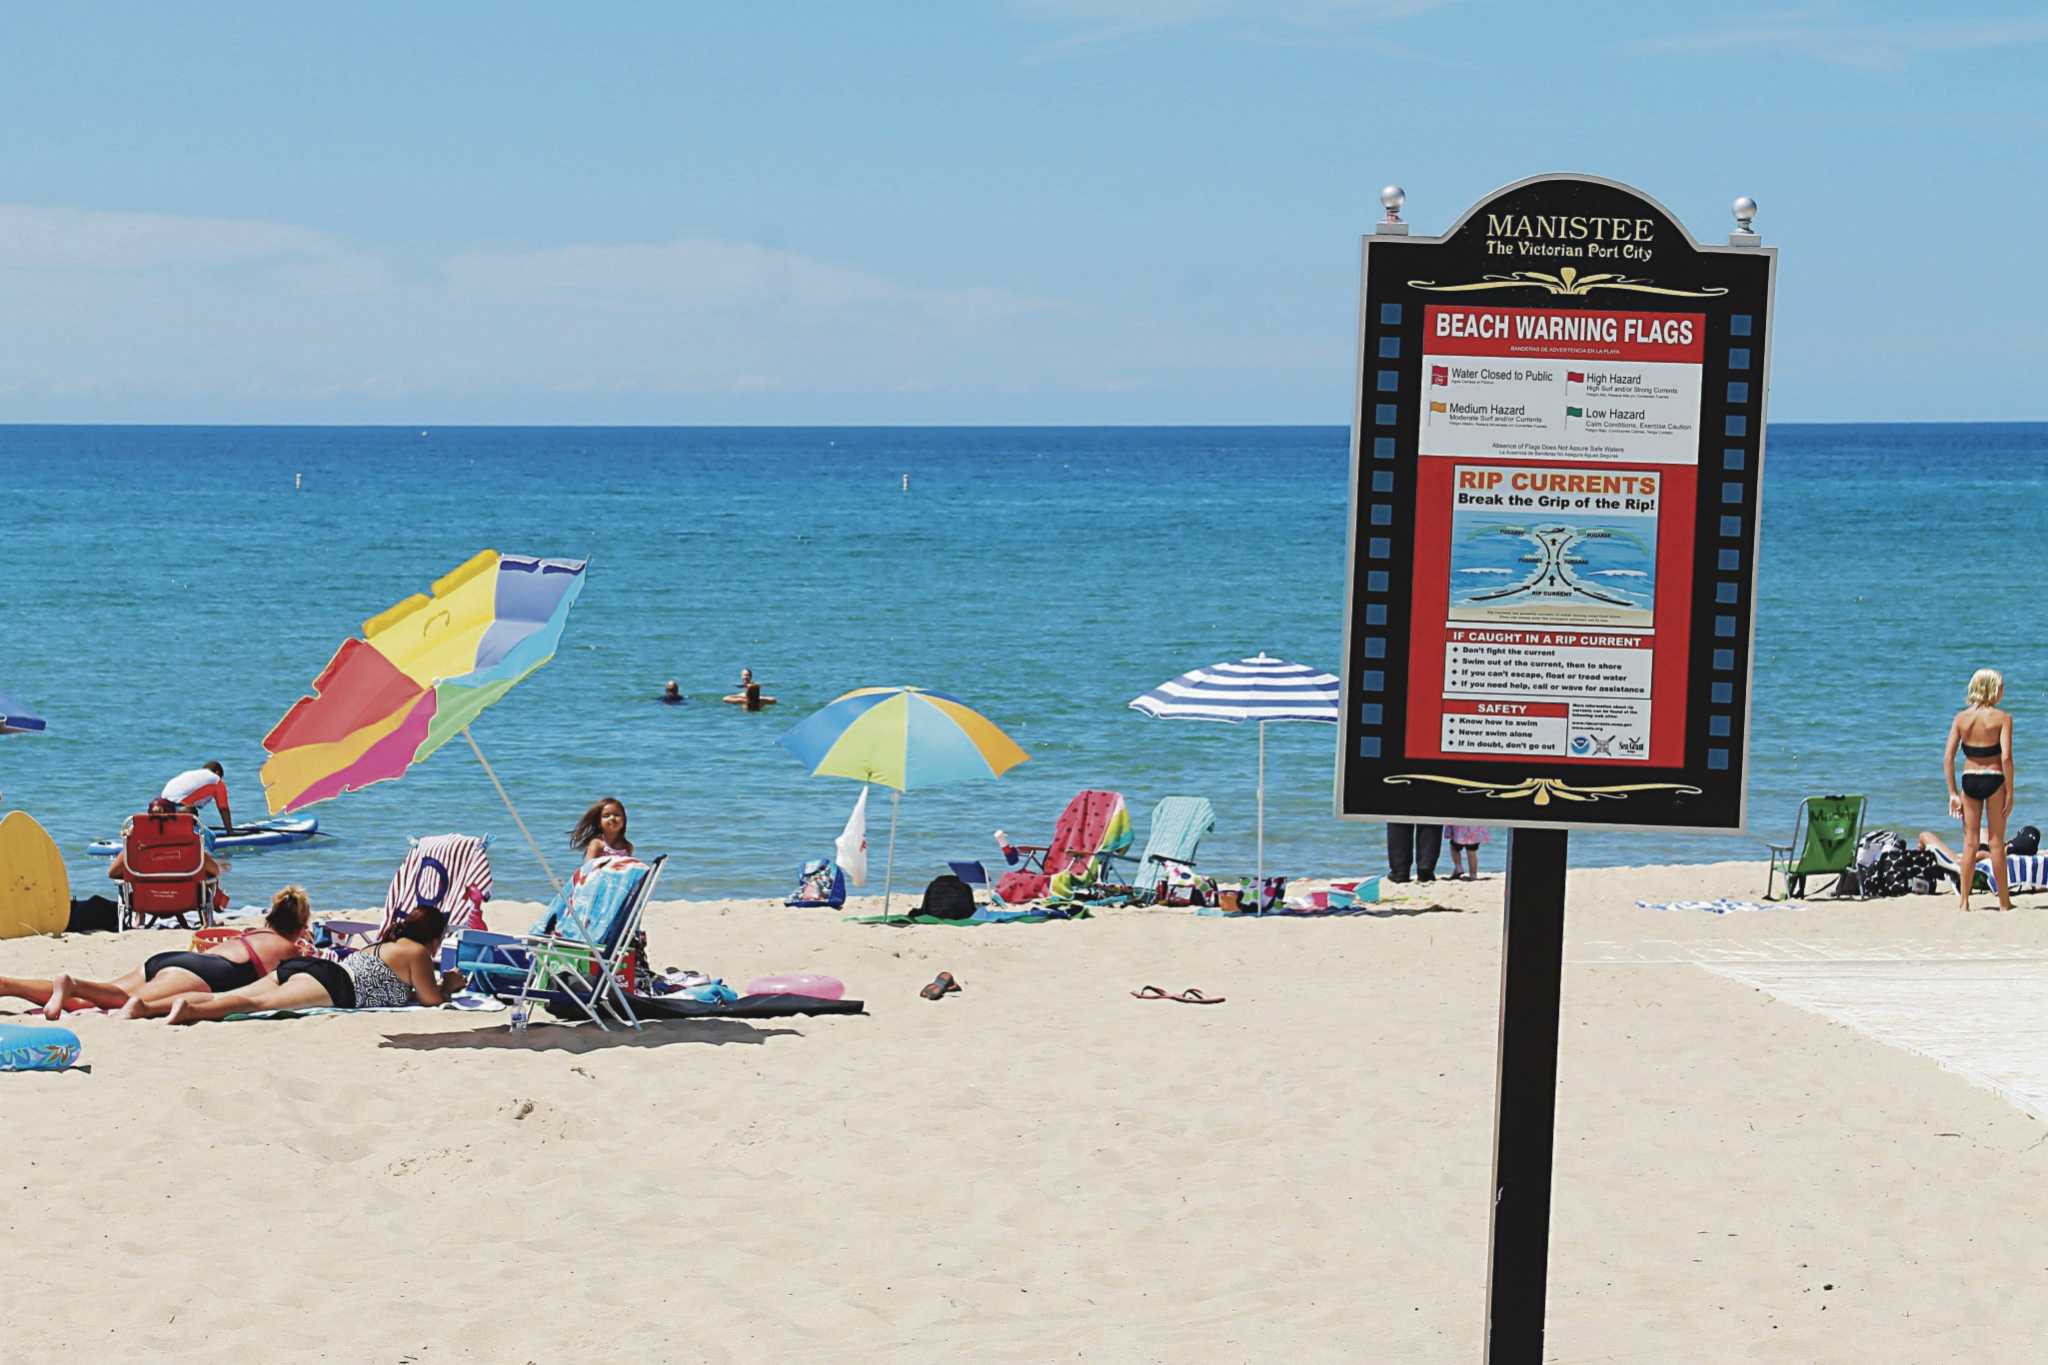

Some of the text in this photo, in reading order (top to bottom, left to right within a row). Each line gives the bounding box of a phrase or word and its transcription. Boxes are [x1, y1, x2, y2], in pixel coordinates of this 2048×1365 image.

[1486, 214, 1655, 241] MANISTEE
[1486, 241, 1652, 261] The Victorian Port City
[1436, 313, 1693, 344] BEACH WARNING FLAGS
[1452, 368, 1552, 381] Water Closed to Public
[1587, 373, 1641, 385] High Hazard
[1634, 386, 1652, 394] Strong
[1450, 403, 1524, 415] Medium Hazard
[1586, 408, 1645, 419] Low Hazard
[1459, 471, 1655, 495] RIP CURRENTS
[1458, 493, 1655, 512] Break the Grip of the Rip!
[1454, 632, 1641, 647] IF CAUGHT IN A RIP CURRENT
[1510, 682, 1530, 690] help,
[1599, 685, 1644, 693] assistance
[1478, 704, 1527, 714] SAFETY
